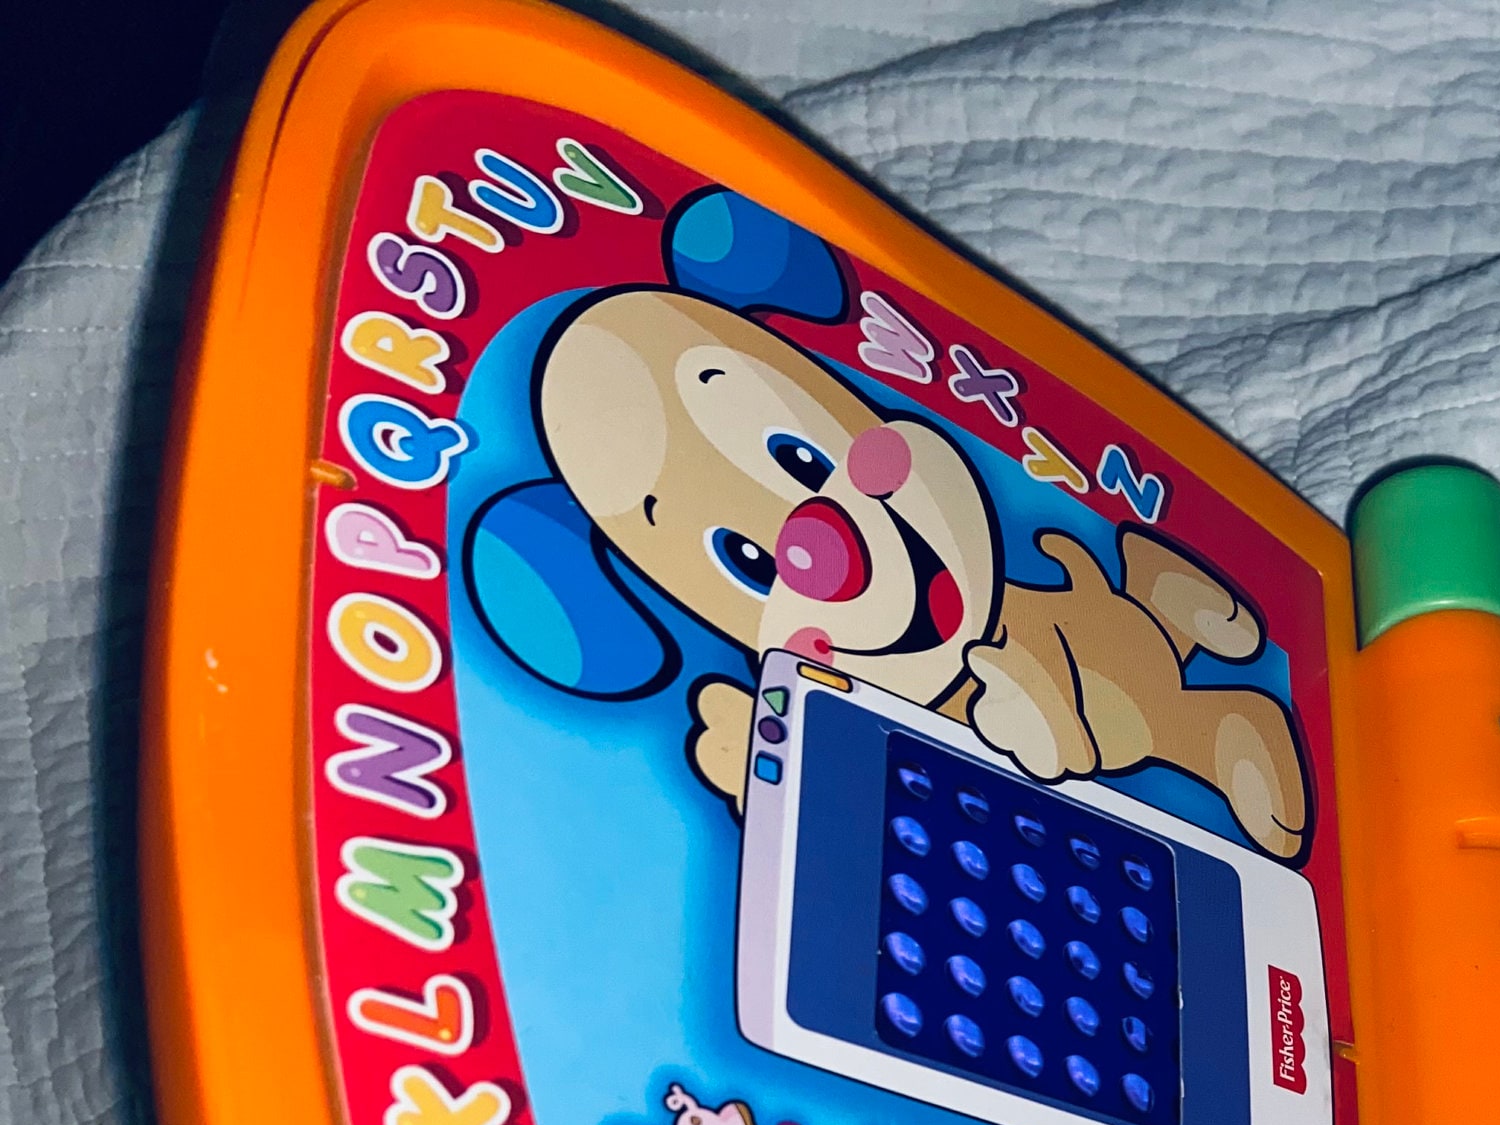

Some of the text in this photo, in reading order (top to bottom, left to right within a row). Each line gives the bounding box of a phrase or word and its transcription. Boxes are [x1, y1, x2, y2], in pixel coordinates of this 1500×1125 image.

[407, 176, 505, 253] T
[469, 149, 565, 234] U
[553, 138, 643, 215] V
[367, 232, 466, 319] S
[341, 311, 450, 394] R
[858, 291, 935, 383] W
[948, 345, 1019, 427] X
[339, 394, 468, 489] Q
[1022, 427, 1089, 494] Y
[1096, 444, 1164, 524] Z
[326, 503, 440, 579] P
[327, 592, 442, 692] O
[325, 704, 451, 818] N
[336, 837, 463, 951] M
[347, 975, 473, 1055] L
[1277, 977, 1296, 1082] Fisher-Price
